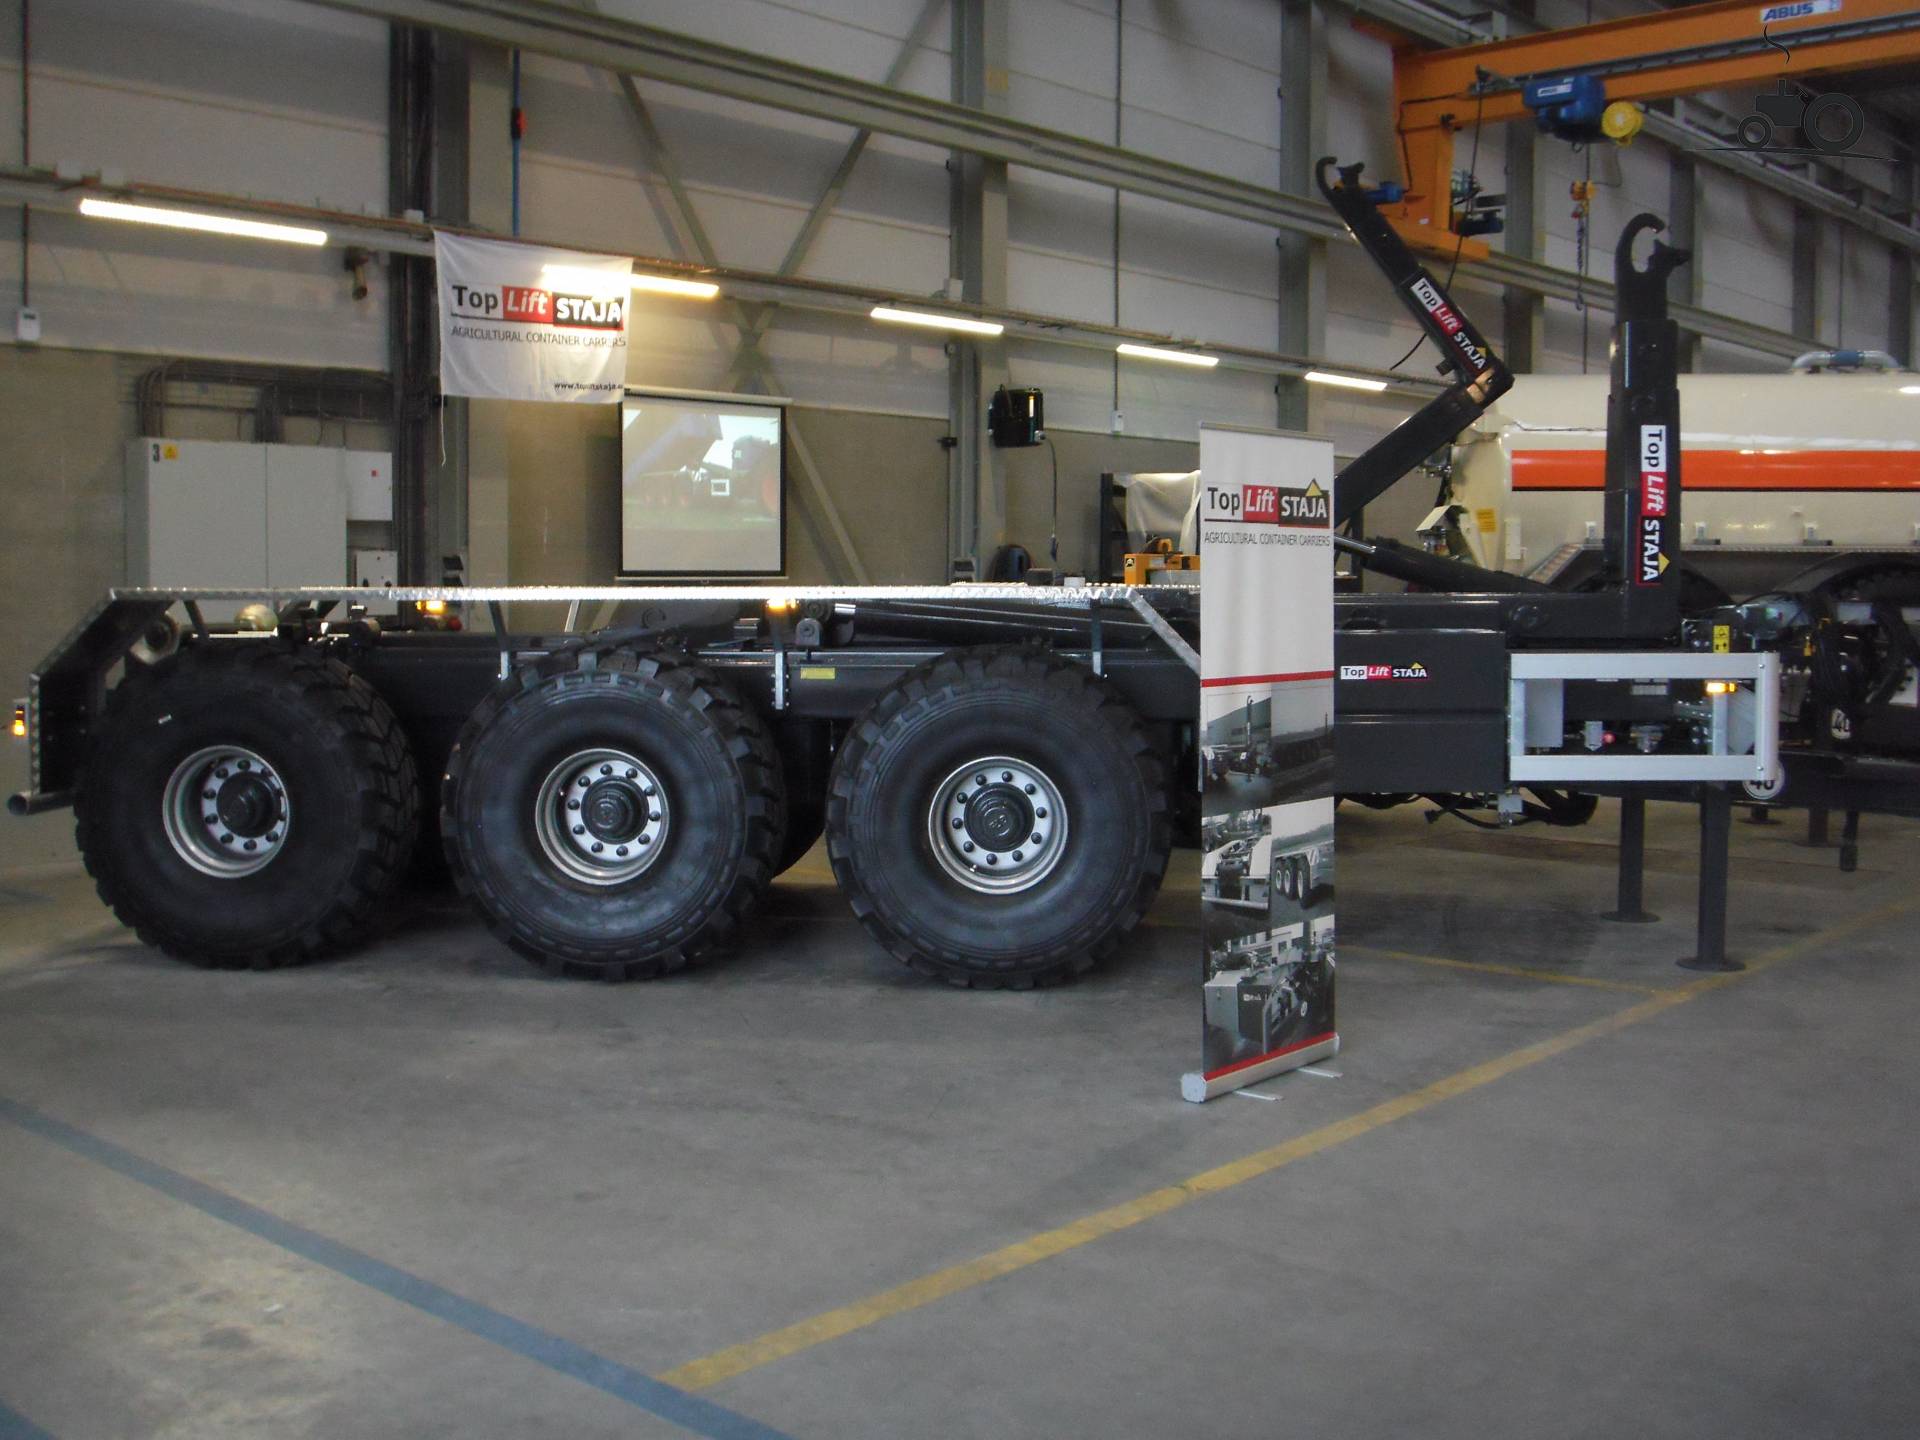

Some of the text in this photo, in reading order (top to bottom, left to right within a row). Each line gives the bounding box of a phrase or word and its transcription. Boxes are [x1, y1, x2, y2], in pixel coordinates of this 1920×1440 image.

[1763, 2, 1814, 21] ABUS
[452, 285, 622, 323] Top Lift STAJA
[452, 325, 626, 348] AGRICULTURAL CONTAINER CARRRS
[1418, 281, 1486, 369] Top Lift STAJA
[1207, 486, 1328, 518] Top Lift STAJA
[1643, 429, 1665, 581] Top Lift STAJA
[1343, 666, 1428, 678] Top Lift STAJA
